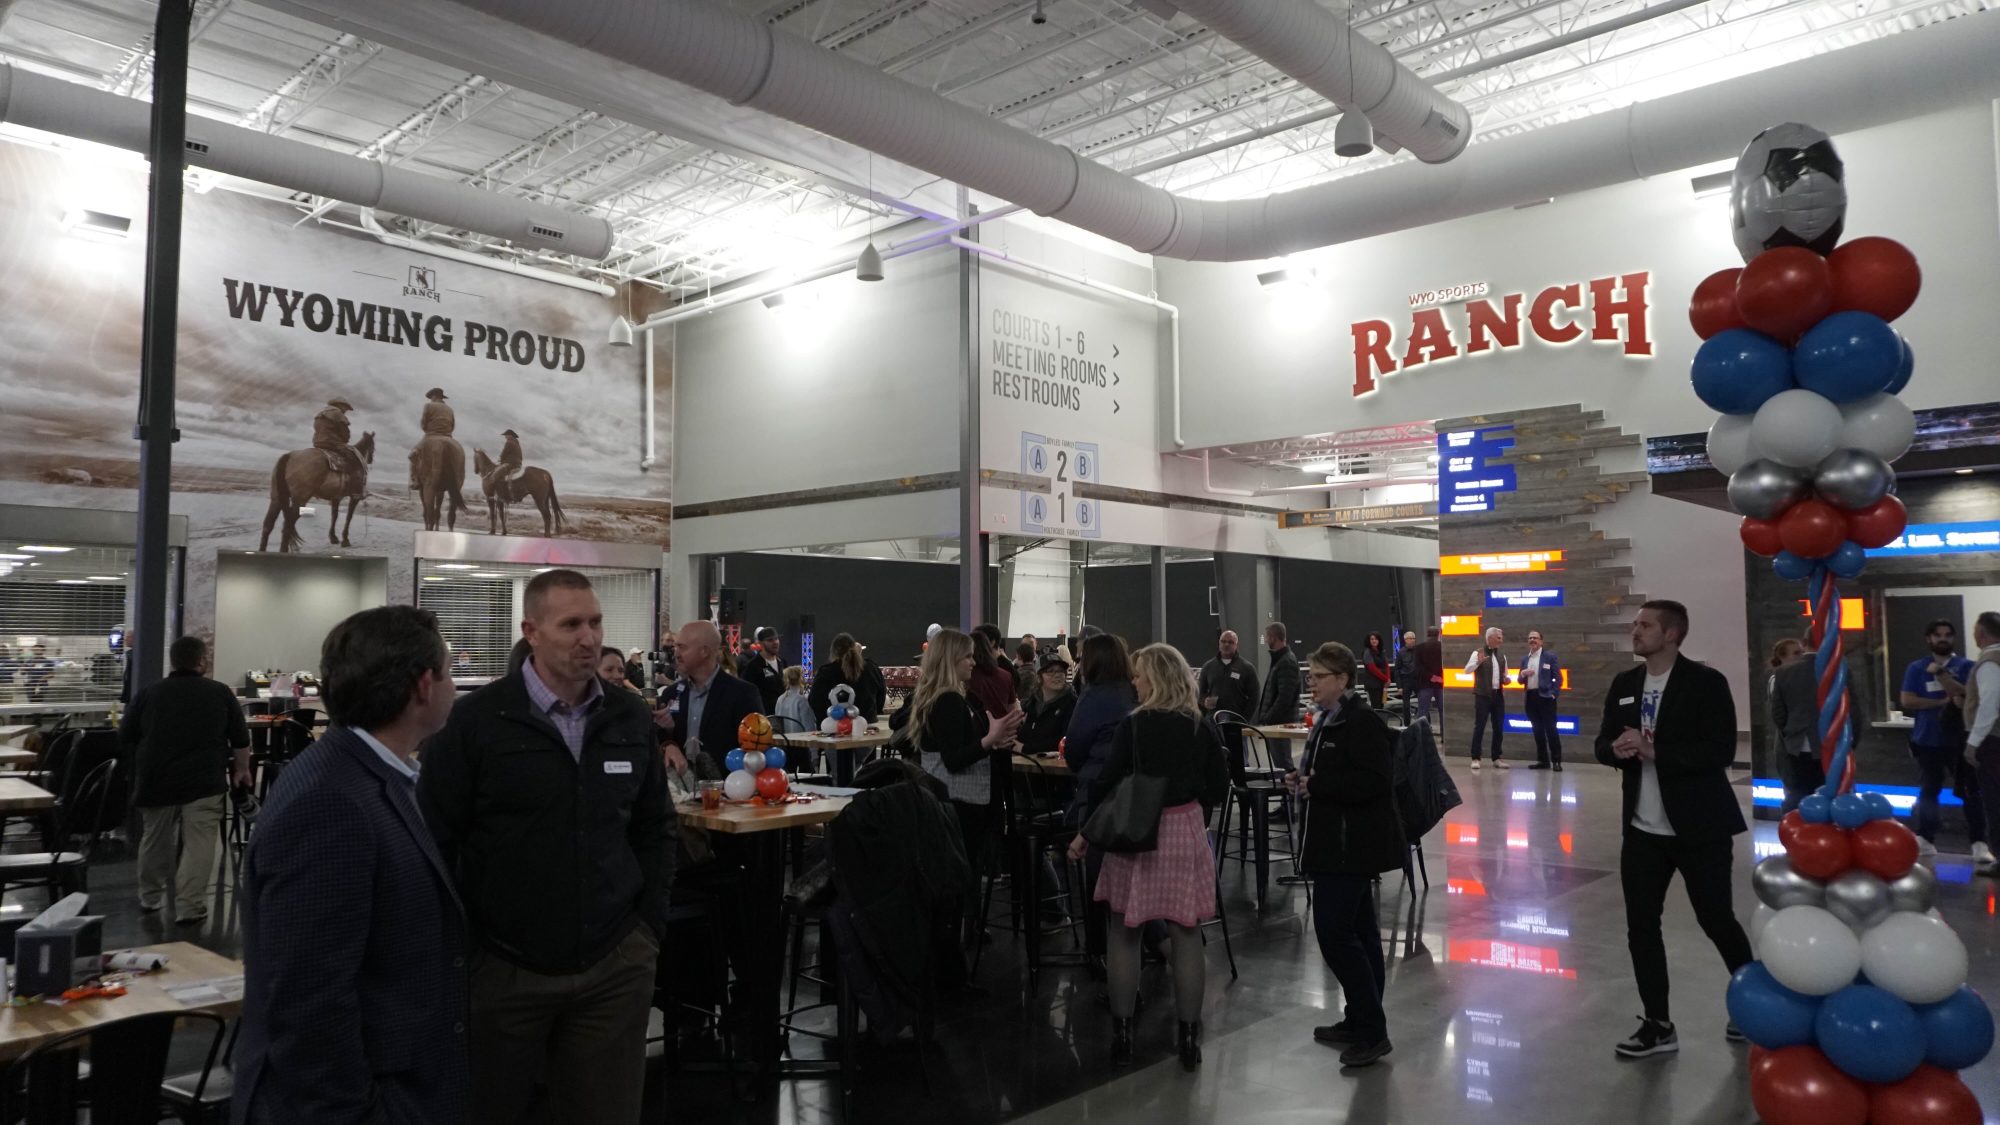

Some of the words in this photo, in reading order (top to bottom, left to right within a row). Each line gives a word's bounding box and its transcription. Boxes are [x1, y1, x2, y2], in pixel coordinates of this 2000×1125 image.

[402, 285, 441, 303] RANCH
[1408, 290, 1435, 306] WYO
[1438, 282, 1486, 301] SPORTS
[223, 277, 454, 353] WYOMING
[463, 320, 586, 373] PROUD
[992, 308, 1050, 346] COURTS
[1055, 324, 1061, 349] 1
[1077, 330, 1085, 355] 6
[1351, 271, 1653, 397] RANCH
[992, 339, 1056, 378] MEETING
[1061, 355, 1107, 388] ROOMS
[992, 369, 1081, 412] RESTROOMS
[1034, 449, 1042, 470] A
[1057, 450, 1067, 483] 2
[1079, 455, 1087, 476] B
[1034, 498, 1042, 520] A
[1058, 492, 1065, 523] 1
[1081, 503, 1088, 524] B
[1335, 511, 1351, 522] PLAY
[1361, 506, 1394, 519] FORWARD
[1396, 504, 1424, 517] COURTS
